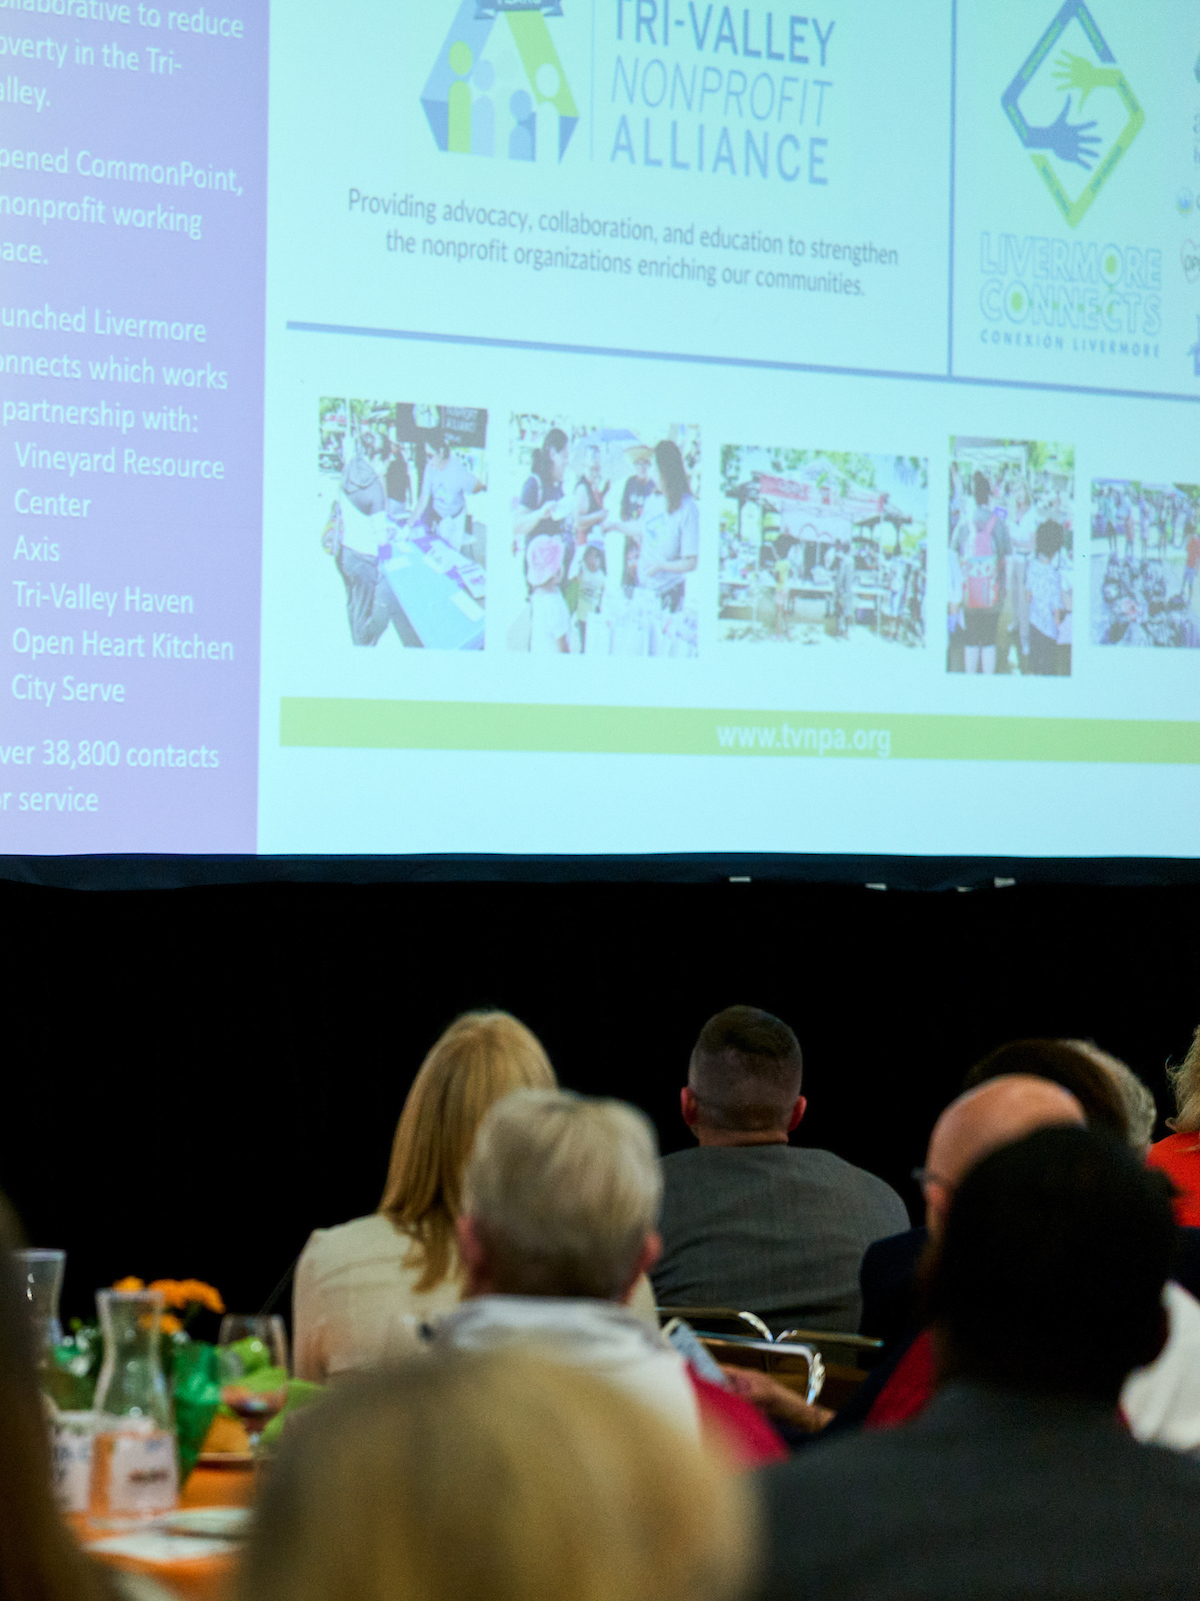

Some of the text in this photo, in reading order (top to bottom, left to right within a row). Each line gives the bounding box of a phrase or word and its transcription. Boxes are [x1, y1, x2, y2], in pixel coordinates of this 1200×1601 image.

[138, 4, 161, 27] to
[168, 7, 244, 38] reduce
[614, 0, 836, 67] TRI-VALLEY
[75, 38, 95, 65] in
[102, 42, 139, 71] the
[146, 47, 183, 75] Tri-
[611, 54, 834, 127] NONPROFIT
[610, 114, 828, 186] ALLIANCE
[76, 150, 244, 197] CommonPoint,
[113, 203, 202, 240] working
[348, 188, 898, 268] Providing advocacy, collaboration, and education to strengthen
[386, 228, 865, 298] the nonprofit organizations enriching our communities.
[980, 230, 1163, 291] LIVERMORE
[94, 308, 206, 343] Livermore
[980, 278, 1161, 337] CONNECTS
[980, 329, 1160, 358] CONEXION LIVERMORE
[89, 354, 155, 384] which
[162, 363, 227, 390] works
[3, 395, 135, 434] partnership
[142, 405, 198, 433] with:
[14, 441, 224, 480] Vineyard Resource
[14, 488, 91, 518] Center
[13, 535, 60, 562] Axis
[13, 581, 193, 617] Tri-Valley Haven
[13, 627, 234, 661] Open Heart Kitchen
[12, 673, 125, 707] City Serve
[42, 739, 120, 770] 38,800
[126, 743, 220, 768] contacts
[716, 722, 891, 757] www.tvnpa.org
[18, 786, 99, 812] service
